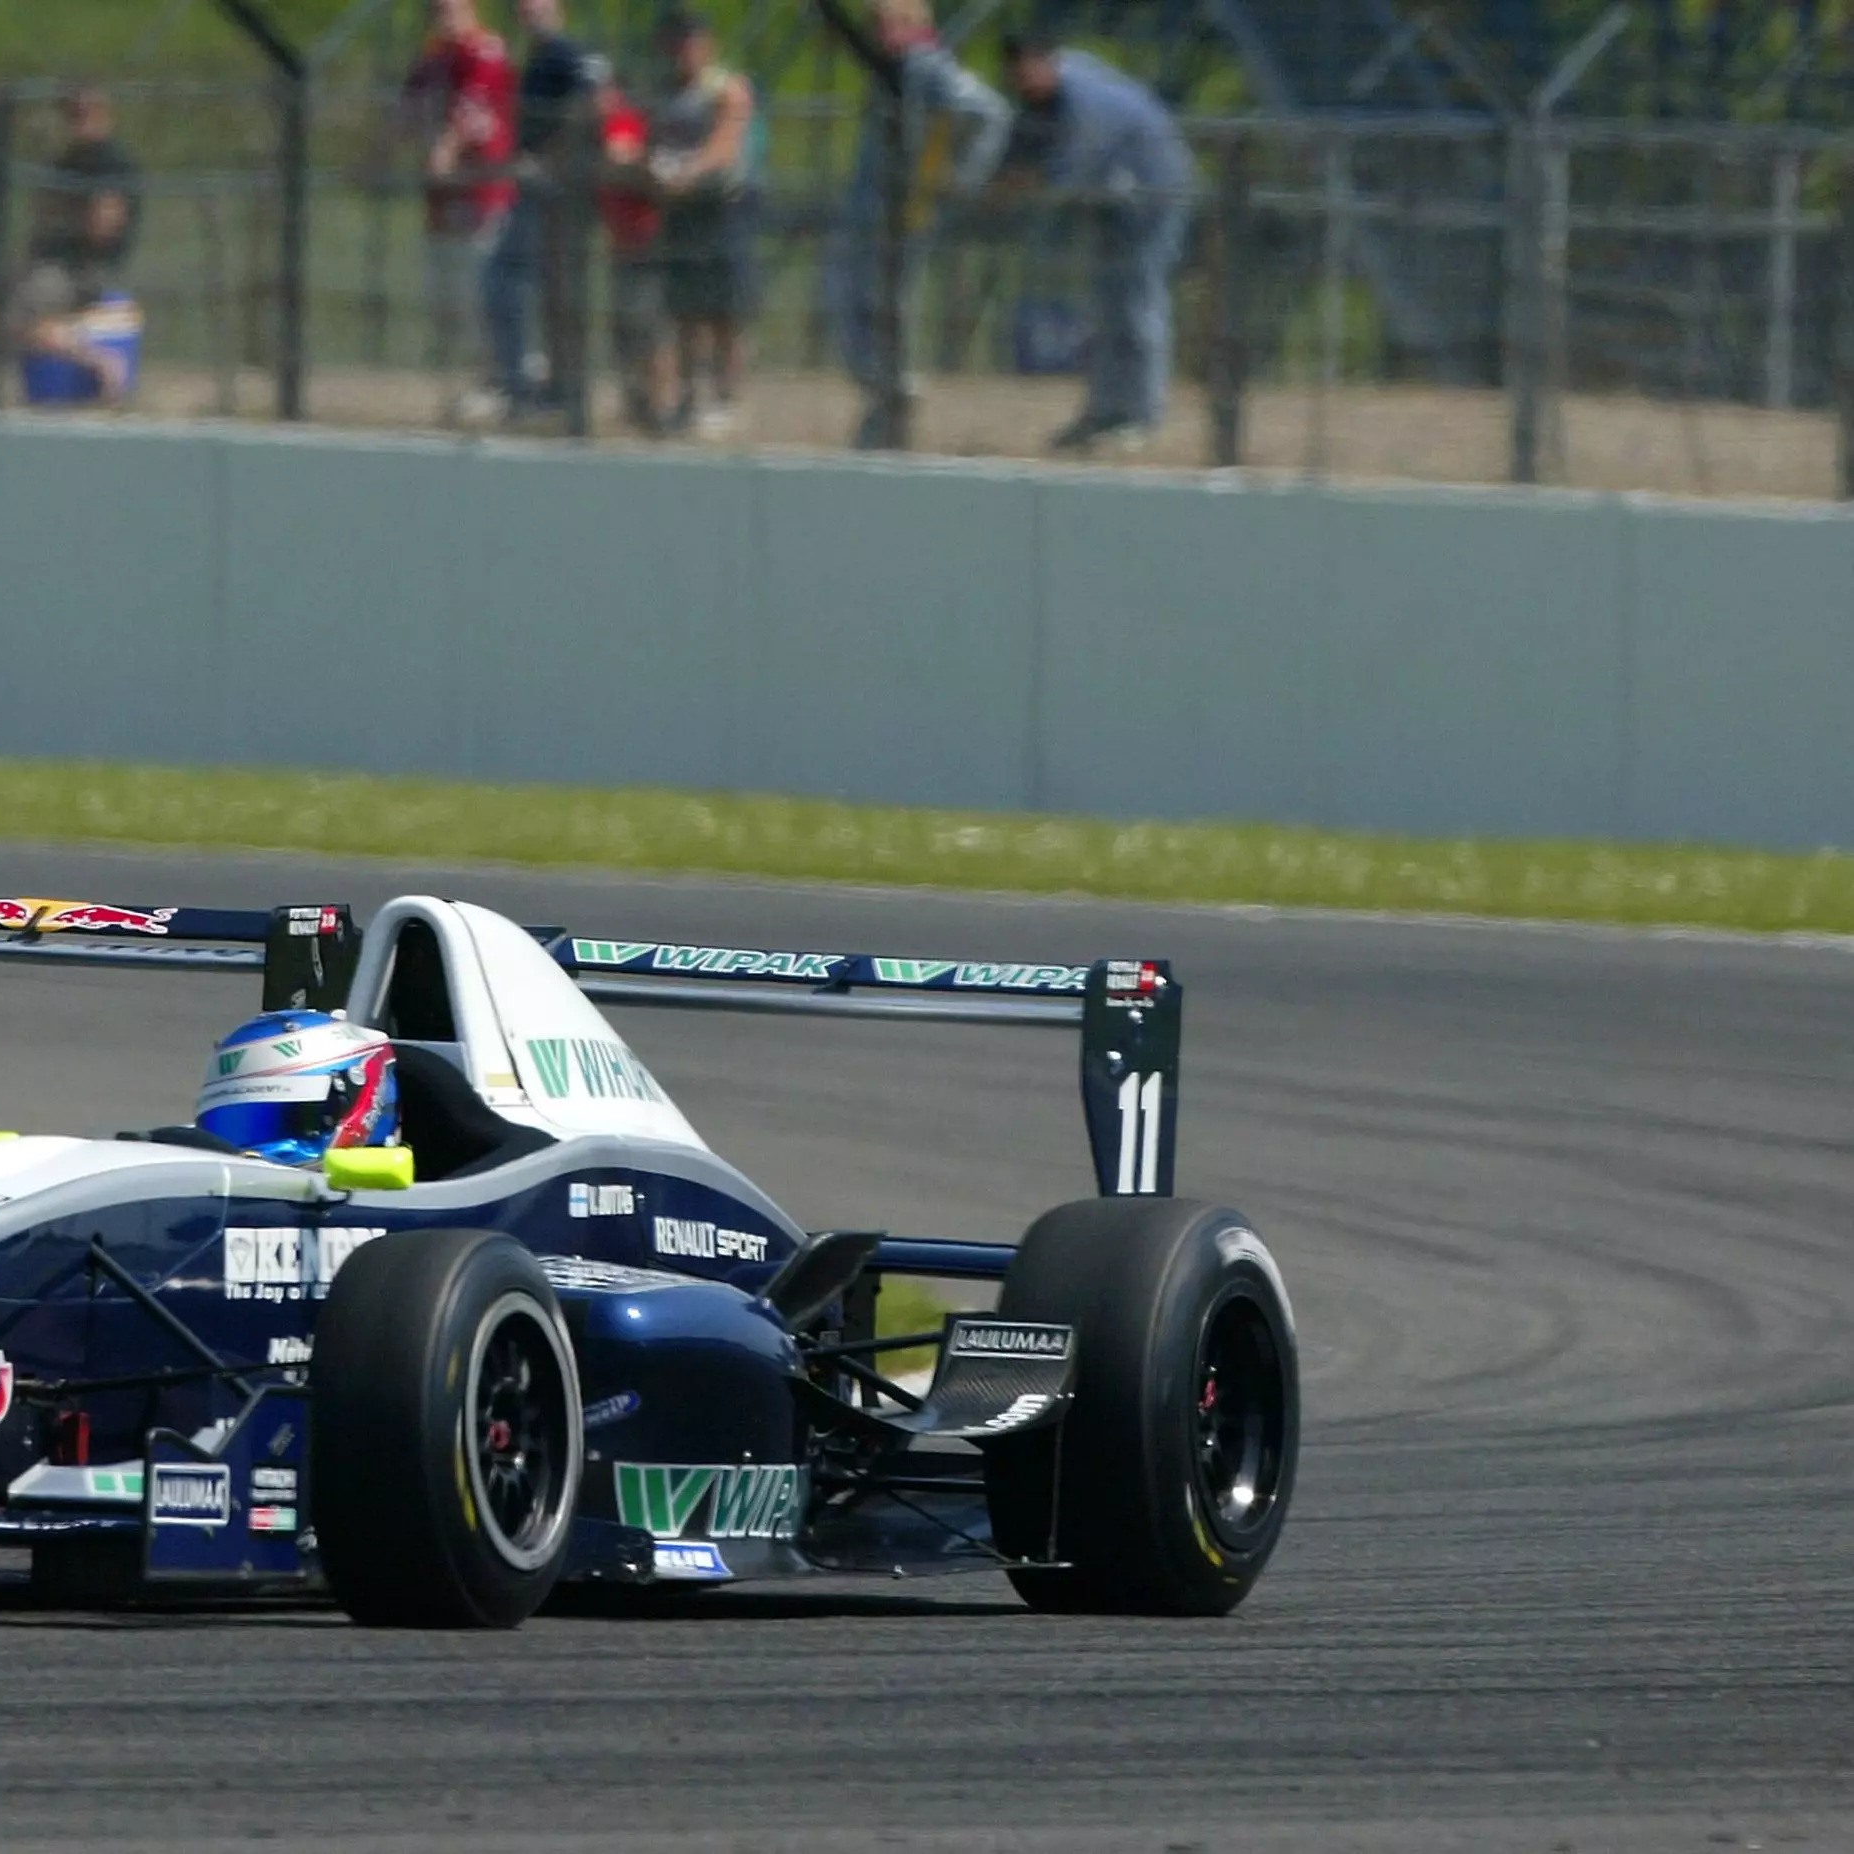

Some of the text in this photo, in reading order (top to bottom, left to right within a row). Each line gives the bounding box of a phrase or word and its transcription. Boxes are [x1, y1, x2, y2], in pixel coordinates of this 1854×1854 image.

[652, 944, 848, 979] WIPAK
[1116, 1070, 1162, 1194] 11
[654, 1217, 769, 1262] RENAULT SPORT
[956, 1328, 1065, 1352] LAULUMAA
